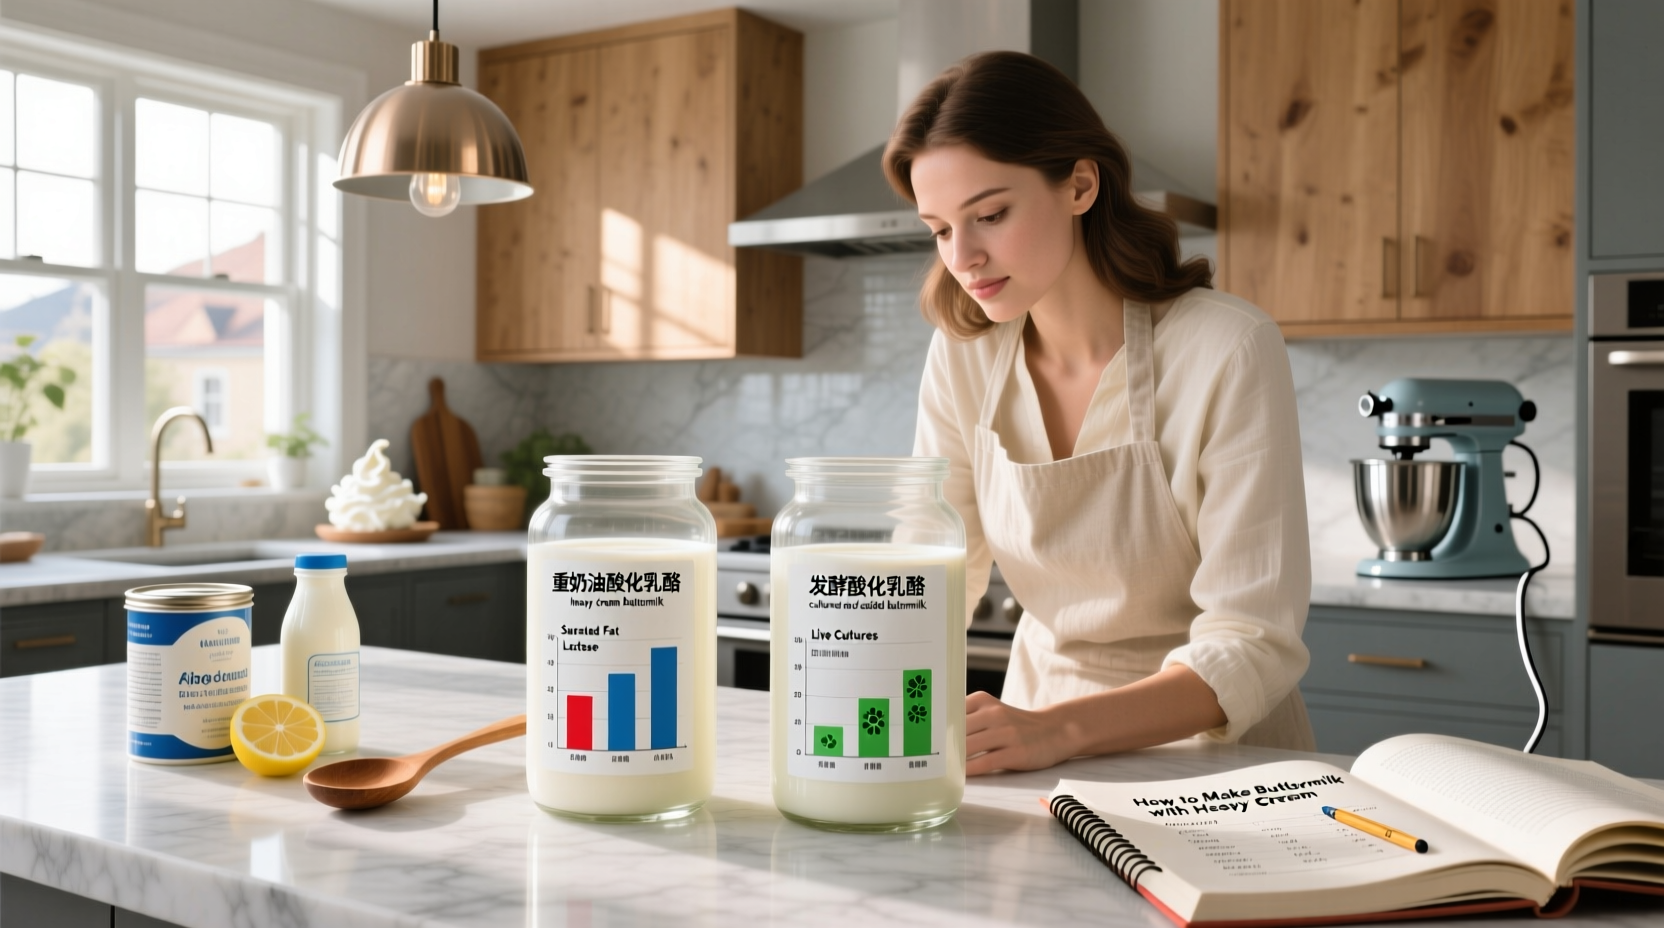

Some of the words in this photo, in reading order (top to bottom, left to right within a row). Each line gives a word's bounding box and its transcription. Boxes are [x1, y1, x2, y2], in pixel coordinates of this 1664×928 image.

[552, 571, 681, 593] 重奶油酸化乳酪
[809, 574, 925, 597] 发酵酸化乳酪
[603, 625, 620, 636] Fat
[811, 629, 832, 641] Live
[1133, 797, 1179, 807] How
[1179, 796, 1199, 804] to
[1202, 789, 1251, 803] Make
[1254, 774, 1344, 795] Buttermilk
[1148, 805, 1190, 818] with
[1194, 800, 1250, 815] Heavy
